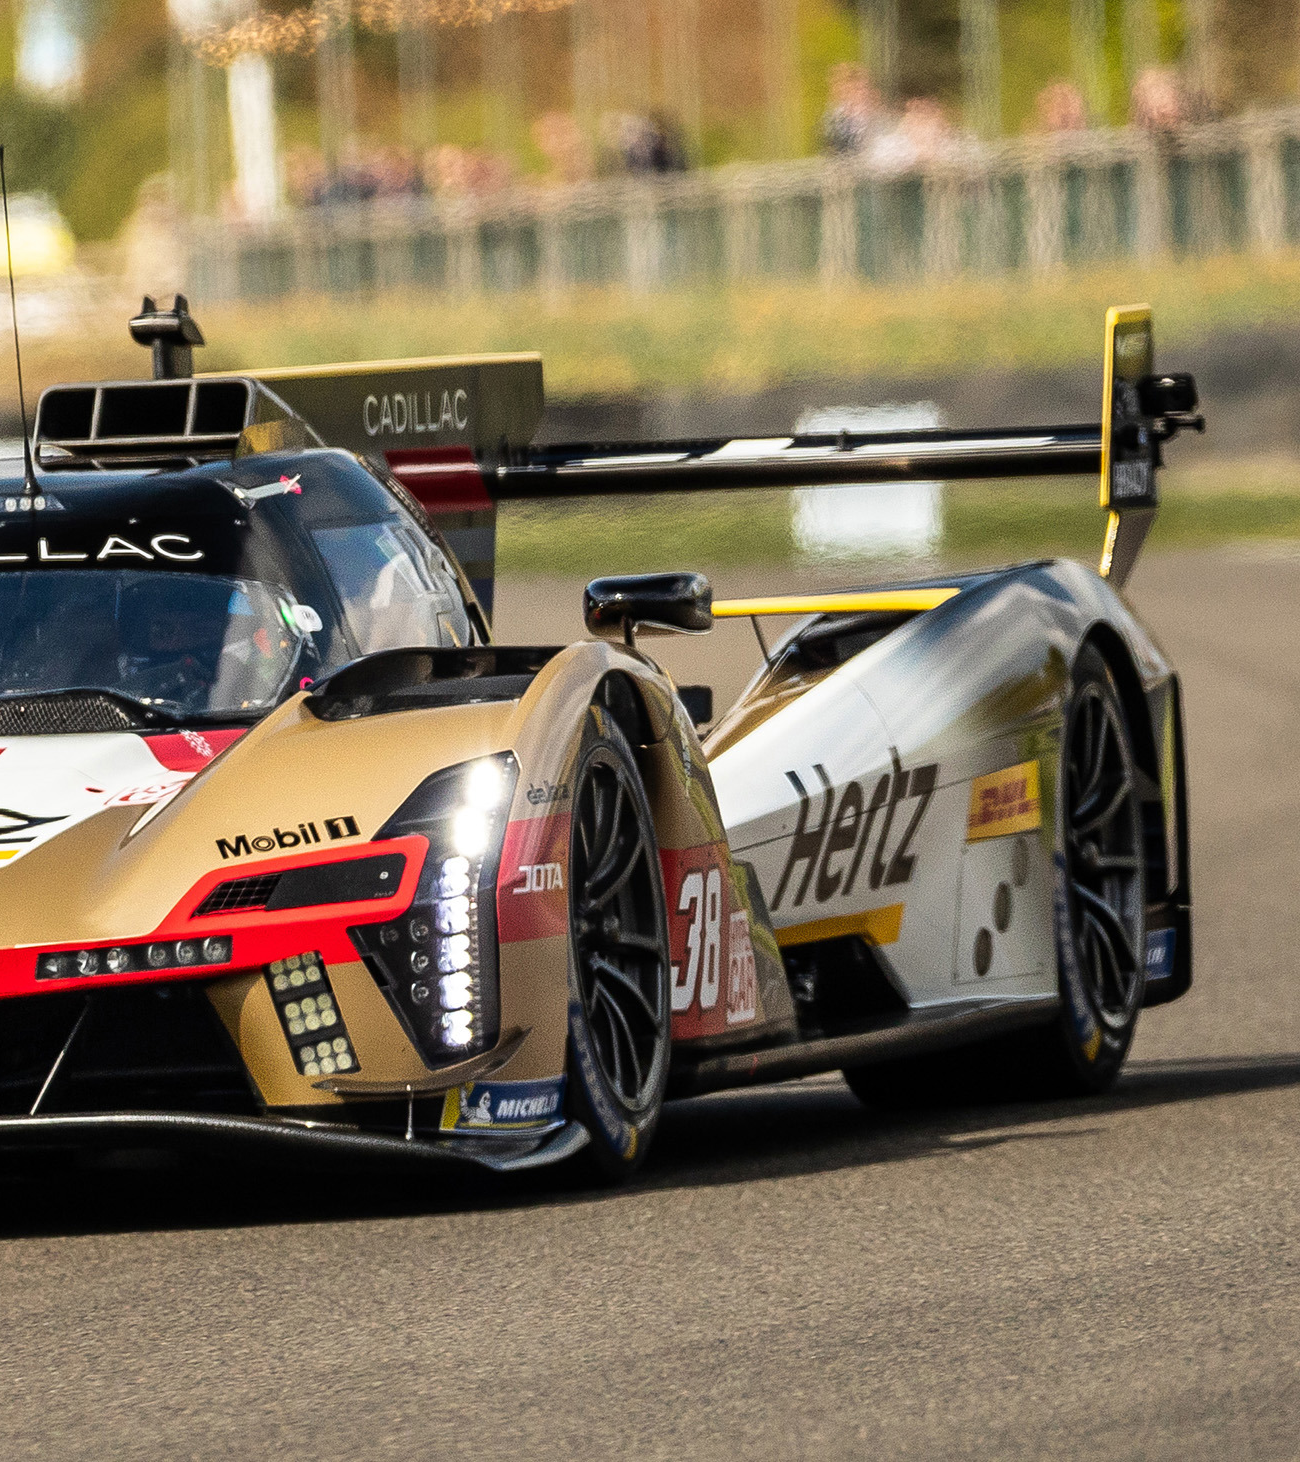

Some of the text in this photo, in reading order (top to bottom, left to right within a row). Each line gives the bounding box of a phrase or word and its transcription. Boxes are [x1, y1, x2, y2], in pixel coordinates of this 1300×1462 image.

[363, 388, 468, 437] CADILLAC
[215, 816, 358, 860] Mobil 1
[770, 746, 939, 912] Hertz
[512, 861, 564, 896] JOTA
[670, 868, 722, 1012] 38
[496, 1092, 559, 1118] MICHELIN
